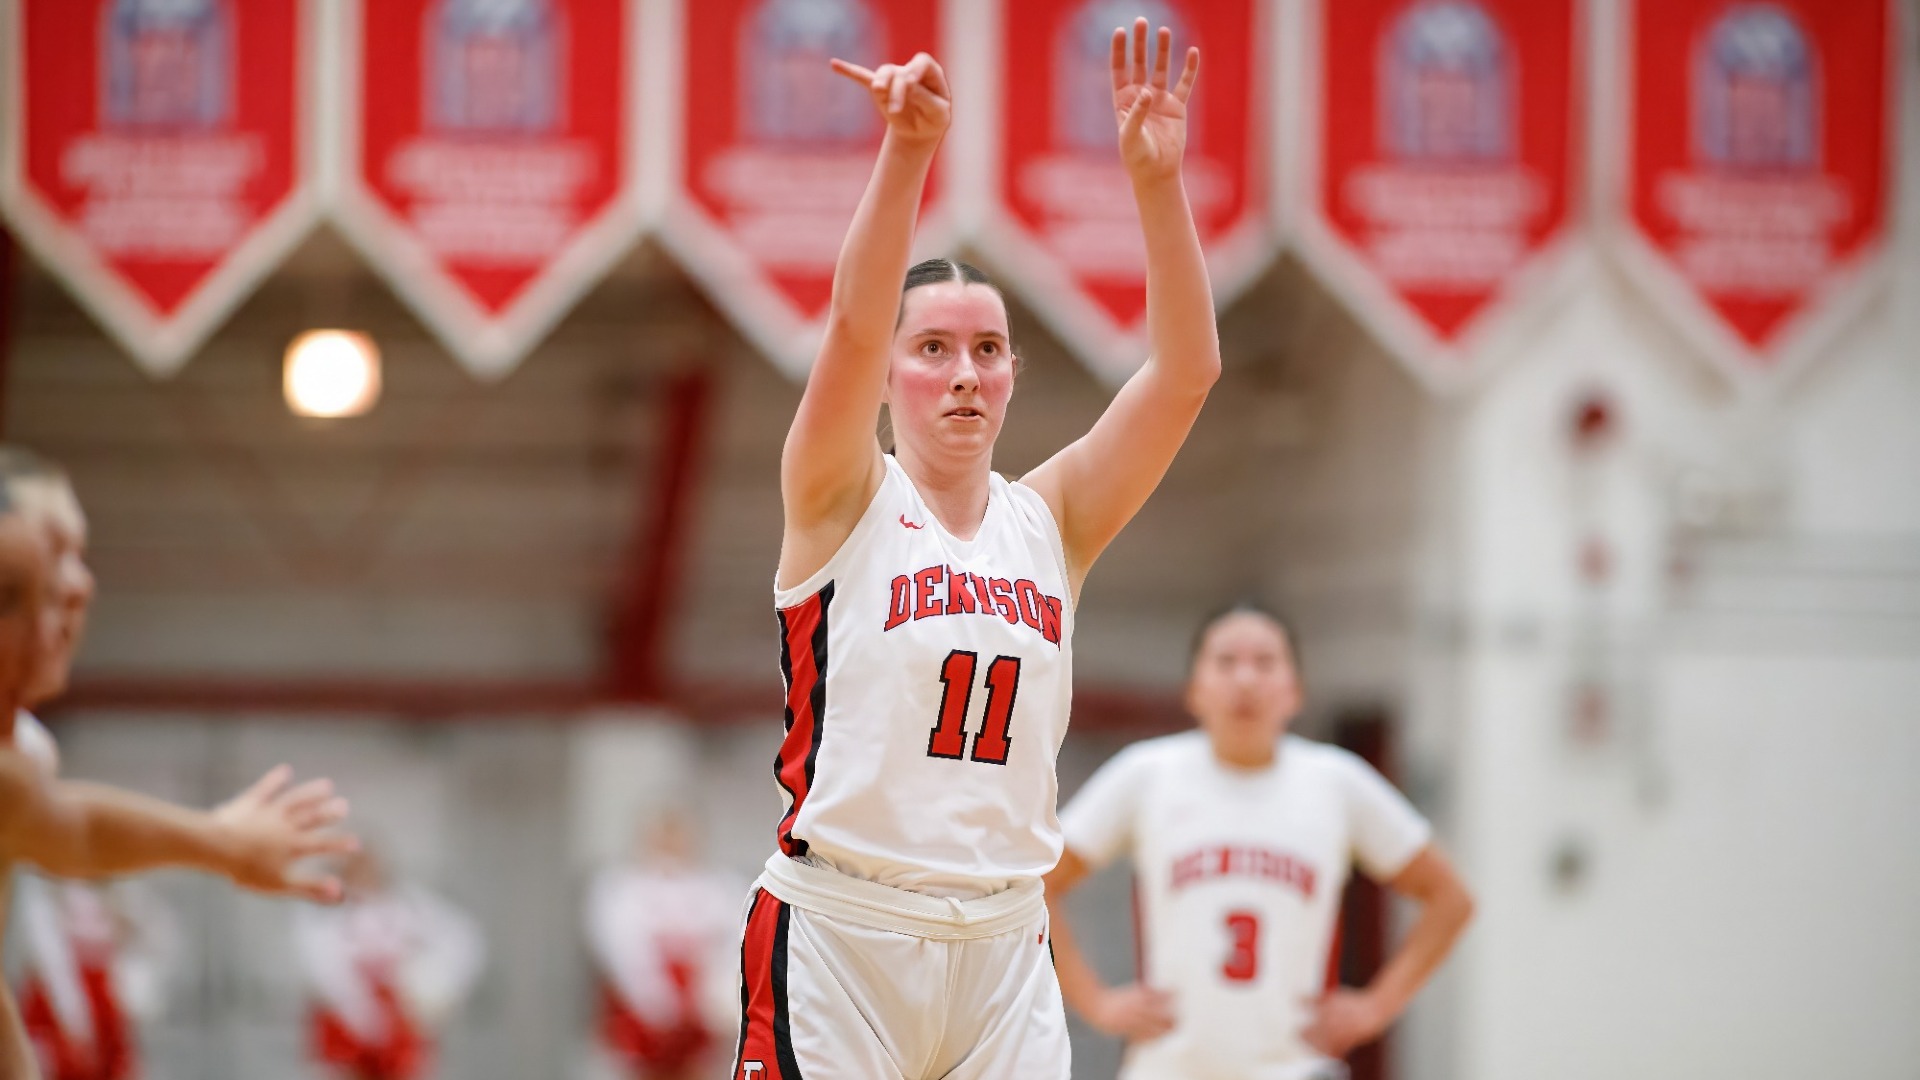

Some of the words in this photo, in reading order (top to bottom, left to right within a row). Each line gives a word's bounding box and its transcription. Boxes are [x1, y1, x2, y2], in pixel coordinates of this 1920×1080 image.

[883, 563, 1063, 652] DENISON
[926, 648, 1022, 766] 11
[1221, 911, 1261, 984] 3
